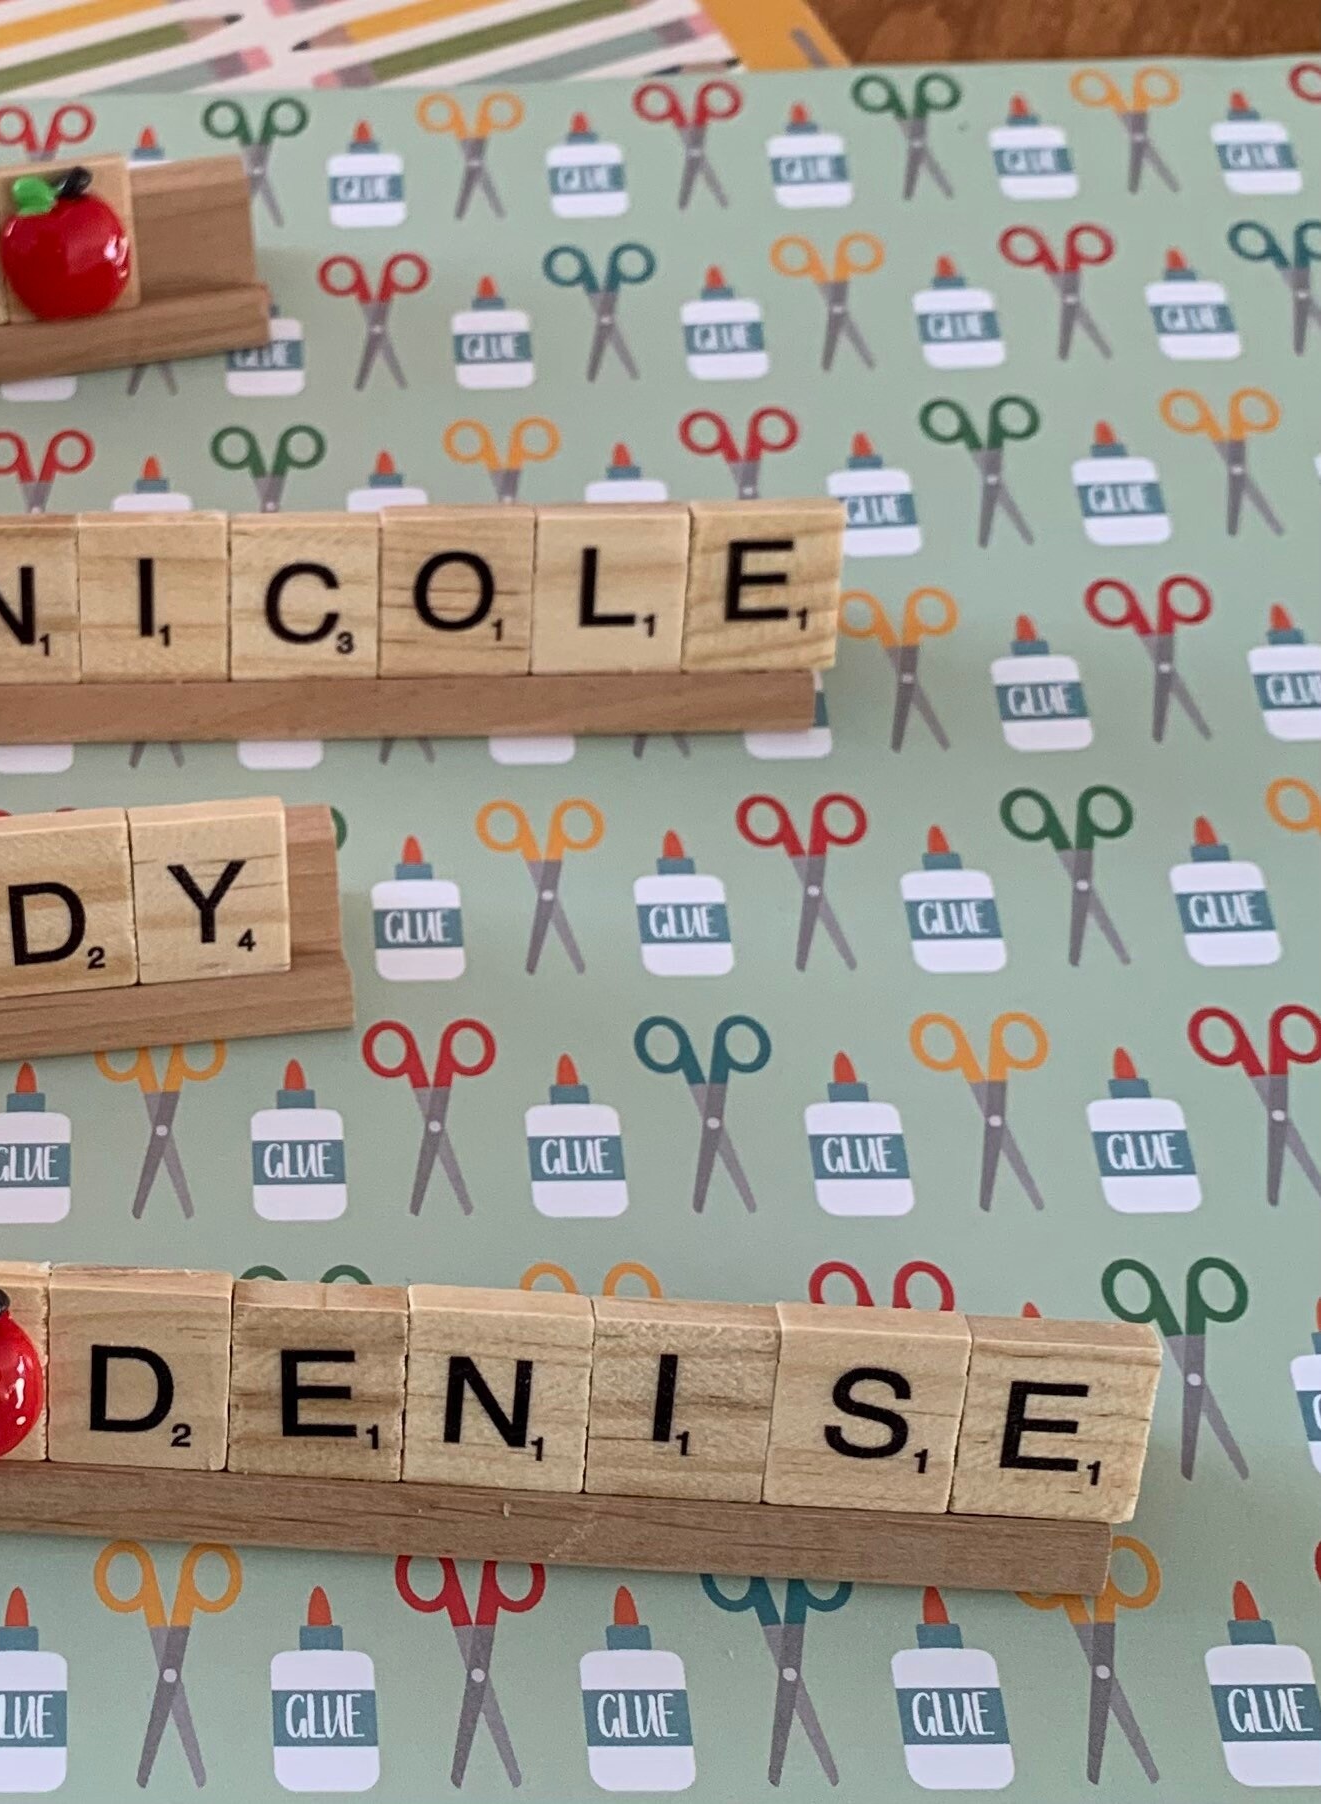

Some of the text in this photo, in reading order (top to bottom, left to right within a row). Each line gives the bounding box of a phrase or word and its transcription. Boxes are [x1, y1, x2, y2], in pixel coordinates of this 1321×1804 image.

[39, 633, 49, 656] 1
[159, 625, 170, 646] 1
[337, 631, 354, 654] 3
[493, 619, 502, 641] 1
[644, 615, 655, 636] 1
[796, 608, 808, 629] 1
[384, 911, 452, 943] GLUE
[650, 905, 719, 937] GLUE
[918, 903, 989, 935] GLUE
[1190, 895, 1262, 926] GLUE
[87, 946, 106, 970] 2
[238, 929, 256, 952] 4
[263, 1142, 334, 1177] GLUE
[541, 1138, 613, 1174] GLUE
[822, 1137, 896, 1173] GLUE
[1108, 1133, 1180, 1168] GLUE
[90, 1345, 1089, 1471] DENISE
[170, 1423, 192, 1448] 2
[365, 1424, 379, 1450] 1
[530, 1436, 544, 1462] 1
[675, 1430, 690, 1457] 1
[913, 1448, 928, 1474] 1
[1086, 1460, 1101, 1486] 1
[285, 1694, 365, 1738] GLUE
[596, 1693, 678, 1737] GLUE
[911, 1692, 995, 1736] GLUE
[1227, 1688, 1314, 1733] GLUE
